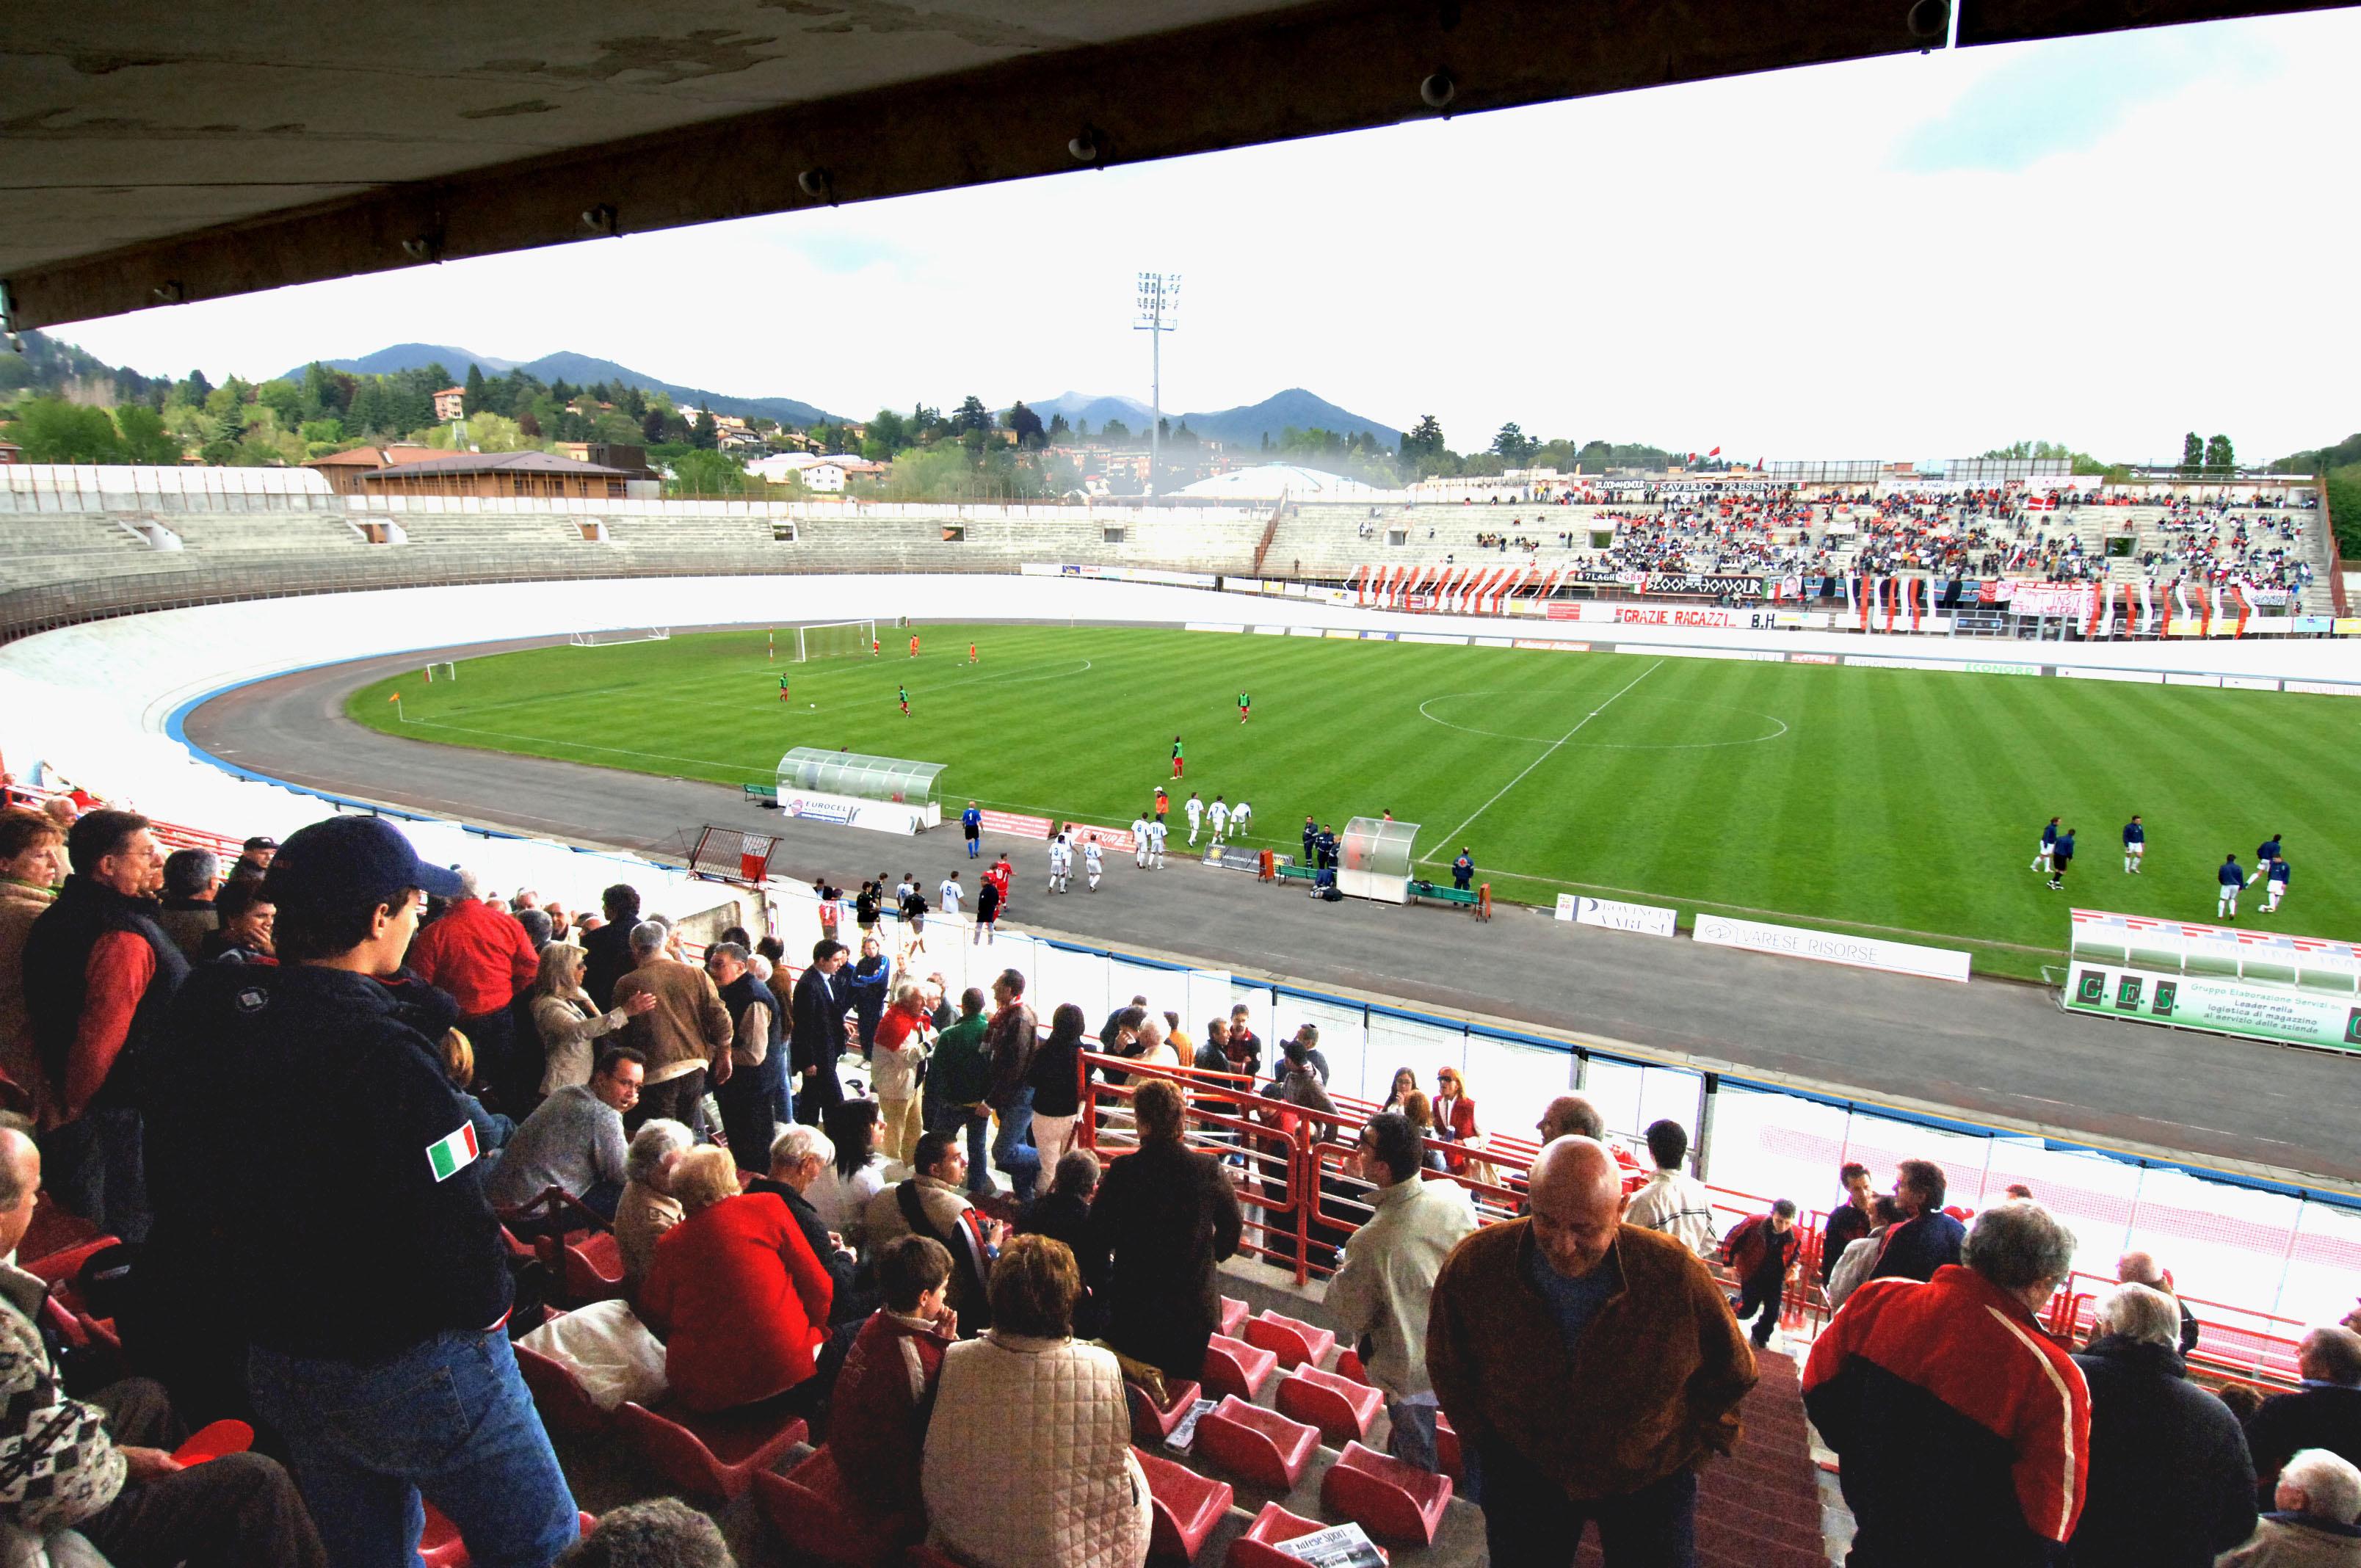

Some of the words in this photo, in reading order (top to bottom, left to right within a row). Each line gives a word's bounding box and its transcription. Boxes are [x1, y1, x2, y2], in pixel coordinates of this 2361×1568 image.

[1591, 573, 1617, 582] LAGH
[1624, 609, 1669, 624] GRAZIE
[1965, 663, 2034, 675] ECONORD
[969, 812, 973, 821] 1
[1137, 824, 1142, 832] 8
[1153, 827, 1158, 835] 11
[1054, 847, 1059, 856] 3
[1087, 846, 1092, 855] 2
[995, 868, 1004, 879] 10
[901, 888, 905, 898] 6
[946, 885, 951, 896] 5
[1740, 929, 1800, 951] VARESE
[1807, 938, 1879, 962] RISORSE
[2191, 983, 2227, 995] Gruppo
[2230, 988, 2292, 1003] Elaborazione
[2295, 998, 2328, 1010] Servizi
[2234, 1000, 2268, 1011] Leader
[2270, 1005, 2293, 1015] nella
[2208, 1003, 2250, 1017] logistica
[2253, 1009, 2262, 1018] di
[2266, 1012, 2318, 1027] magazzino
[2203, 1011, 2213, 1019] al
[2216, 1015, 2252, 1026] servizio
[2255, 1017, 2278, 1029] delle
[2281, 1023, 2319, 1035] aziende
[1322, 1528, 1347, 1543] Sport
